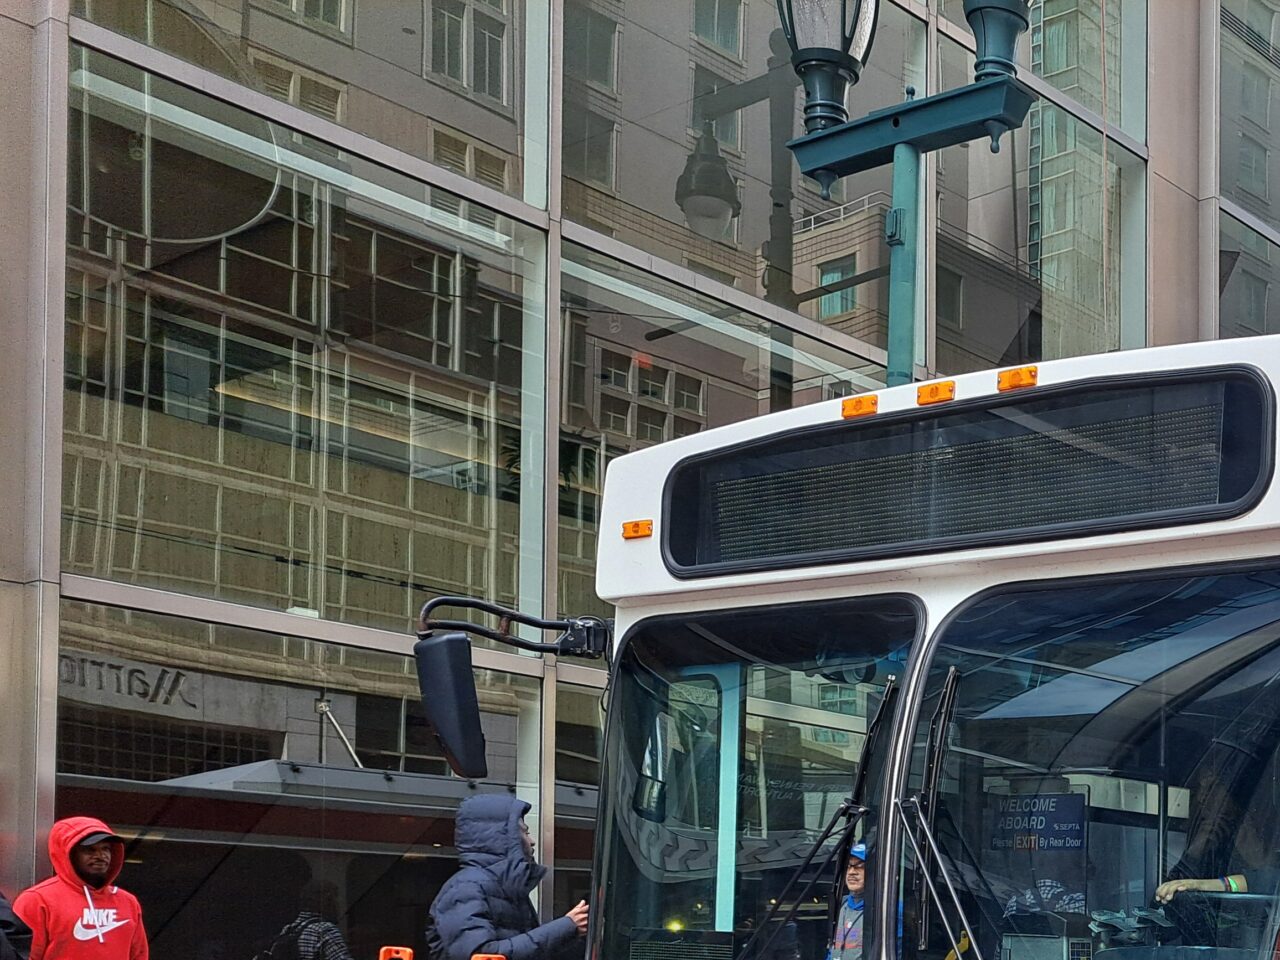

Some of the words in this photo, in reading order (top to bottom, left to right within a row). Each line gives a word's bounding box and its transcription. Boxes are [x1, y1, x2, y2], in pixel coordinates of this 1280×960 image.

[999, 798, 1057, 812] WELCOME
[998, 816, 1046, 830] ABOARD
[1059, 823, 1080, 831] SEPTA
[1015, 836, 1036, 849] EXIT
[1039, 837, 1048, 849] By
[1049, 837, 1064, 847] Rear
[1065, 837, 1082, 847] Door
